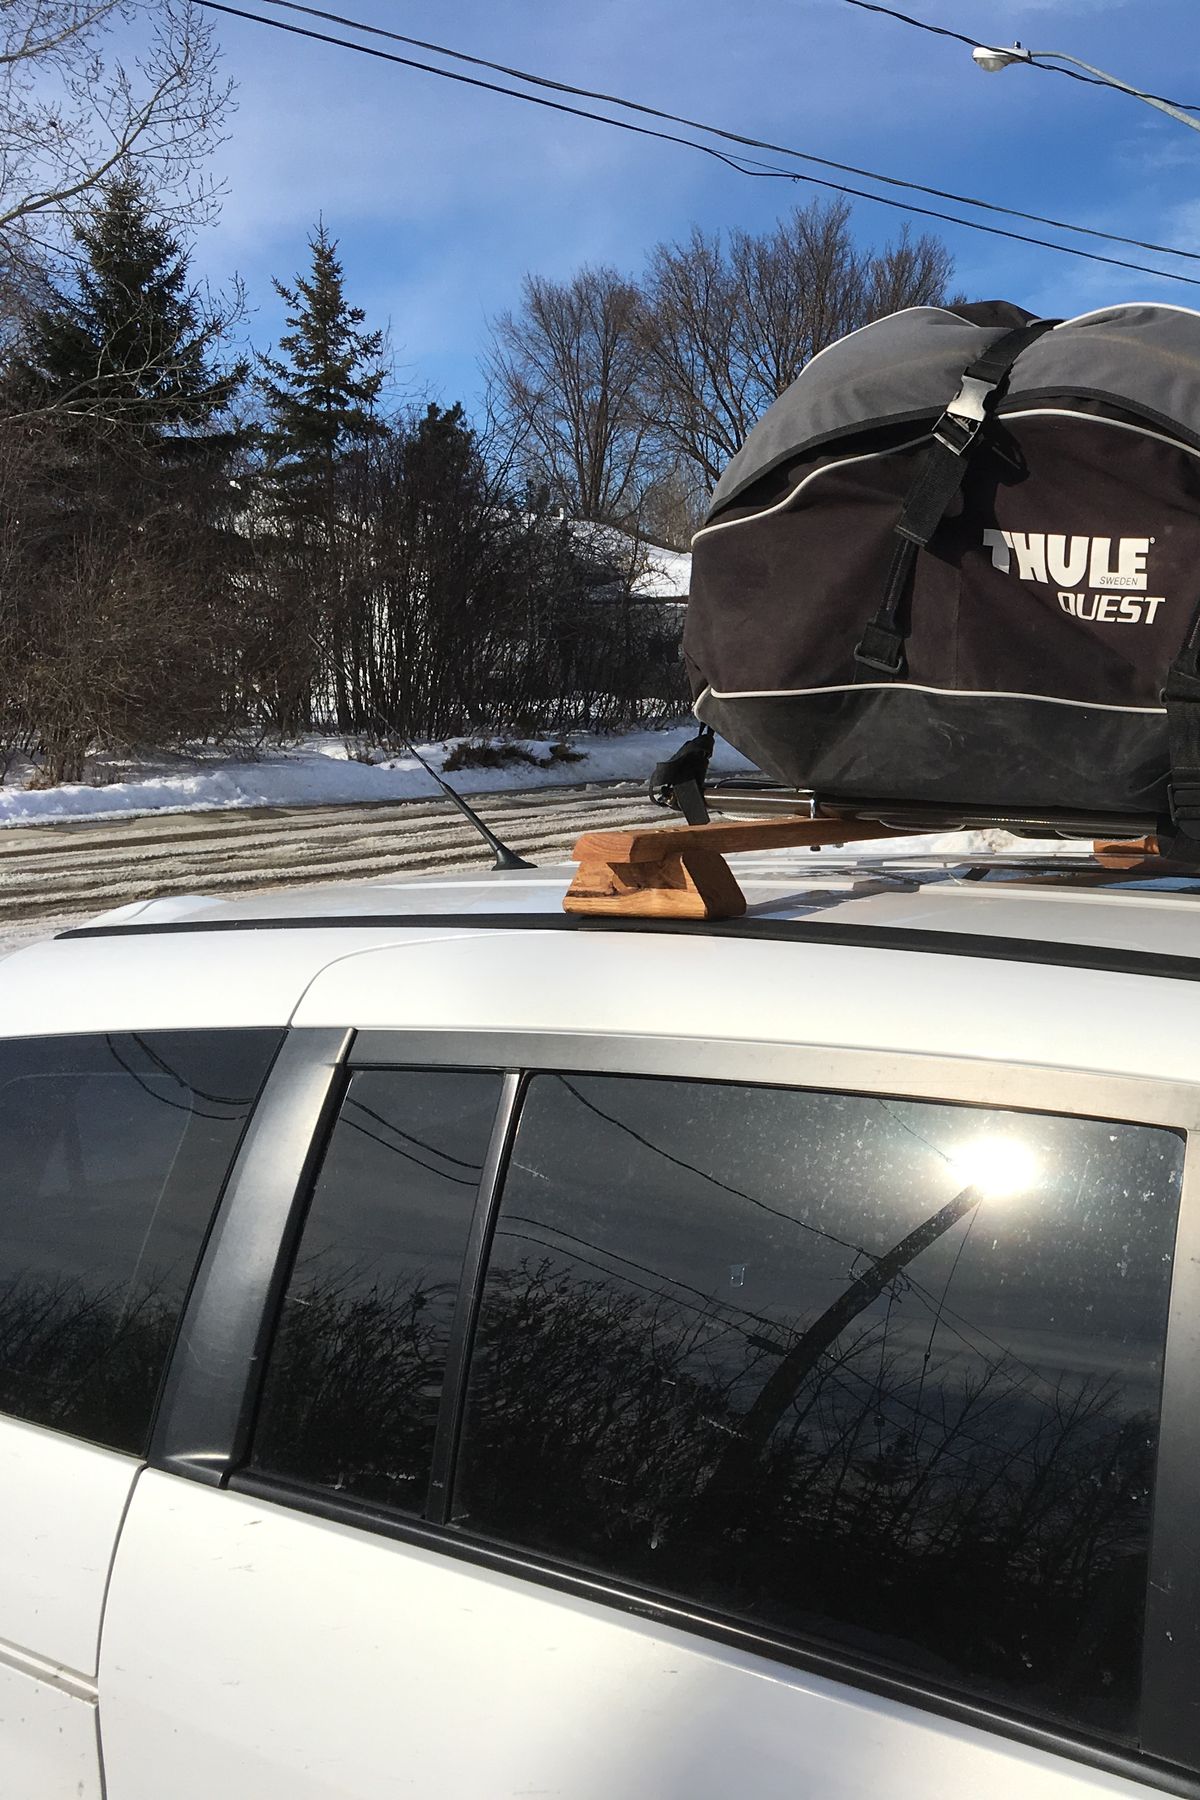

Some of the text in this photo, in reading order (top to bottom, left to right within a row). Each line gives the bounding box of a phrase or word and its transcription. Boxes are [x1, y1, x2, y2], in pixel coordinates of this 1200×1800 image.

[983, 528, 1150, 590] THULE
[1099, 575, 1139, 586] SWEDEN
[1056, 591, 1166, 625] QUEST
